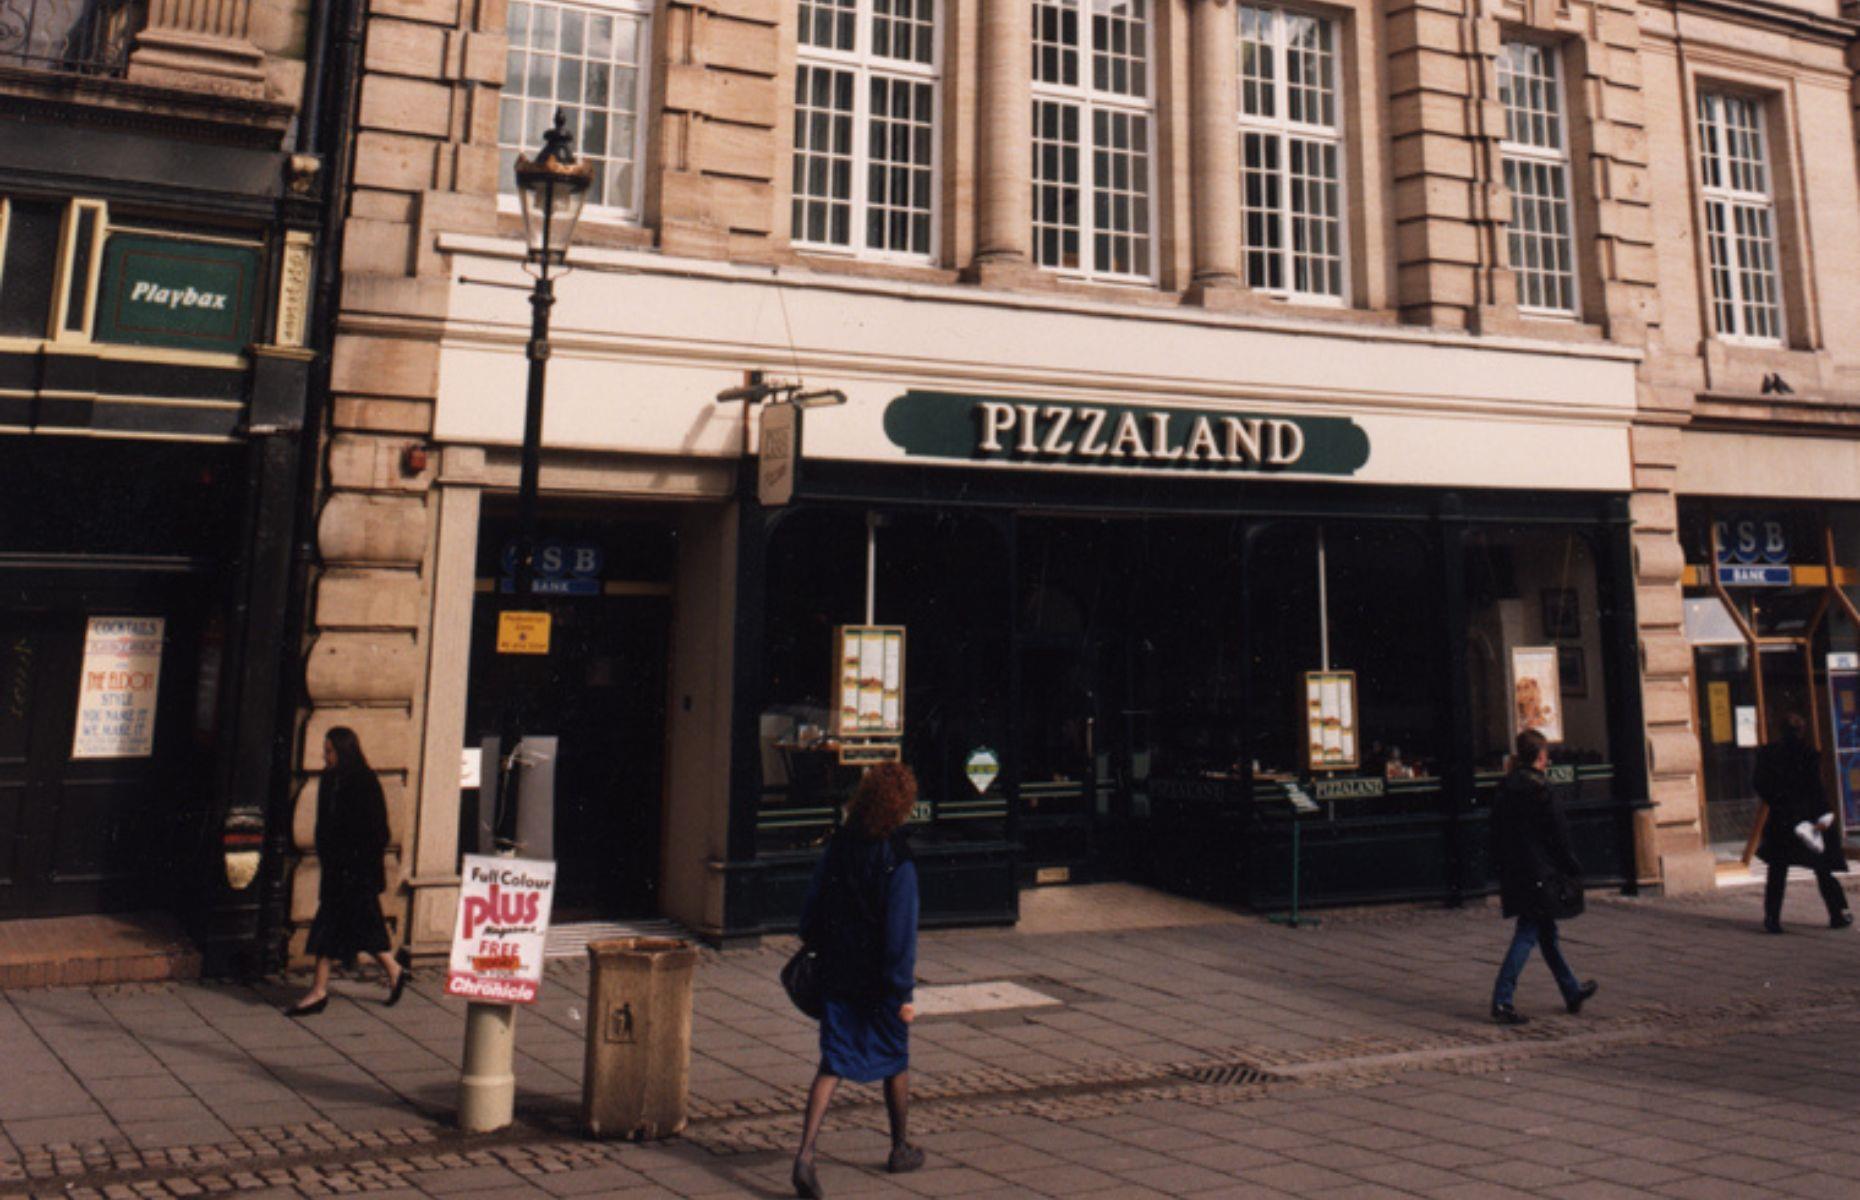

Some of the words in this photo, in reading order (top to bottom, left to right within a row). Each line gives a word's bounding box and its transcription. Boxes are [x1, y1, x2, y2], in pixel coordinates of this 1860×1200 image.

[978, 401, 1305, 466] PIZZALAND
[1733, 567, 1767, 582] BANK
[471, 867, 499, 884] Full
[501, 870, 551, 889] Colour
[462, 884, 540, 939] plus
[479, 940, 520, 957] FREE
[450, 976, 535, 1001] Chronicle
